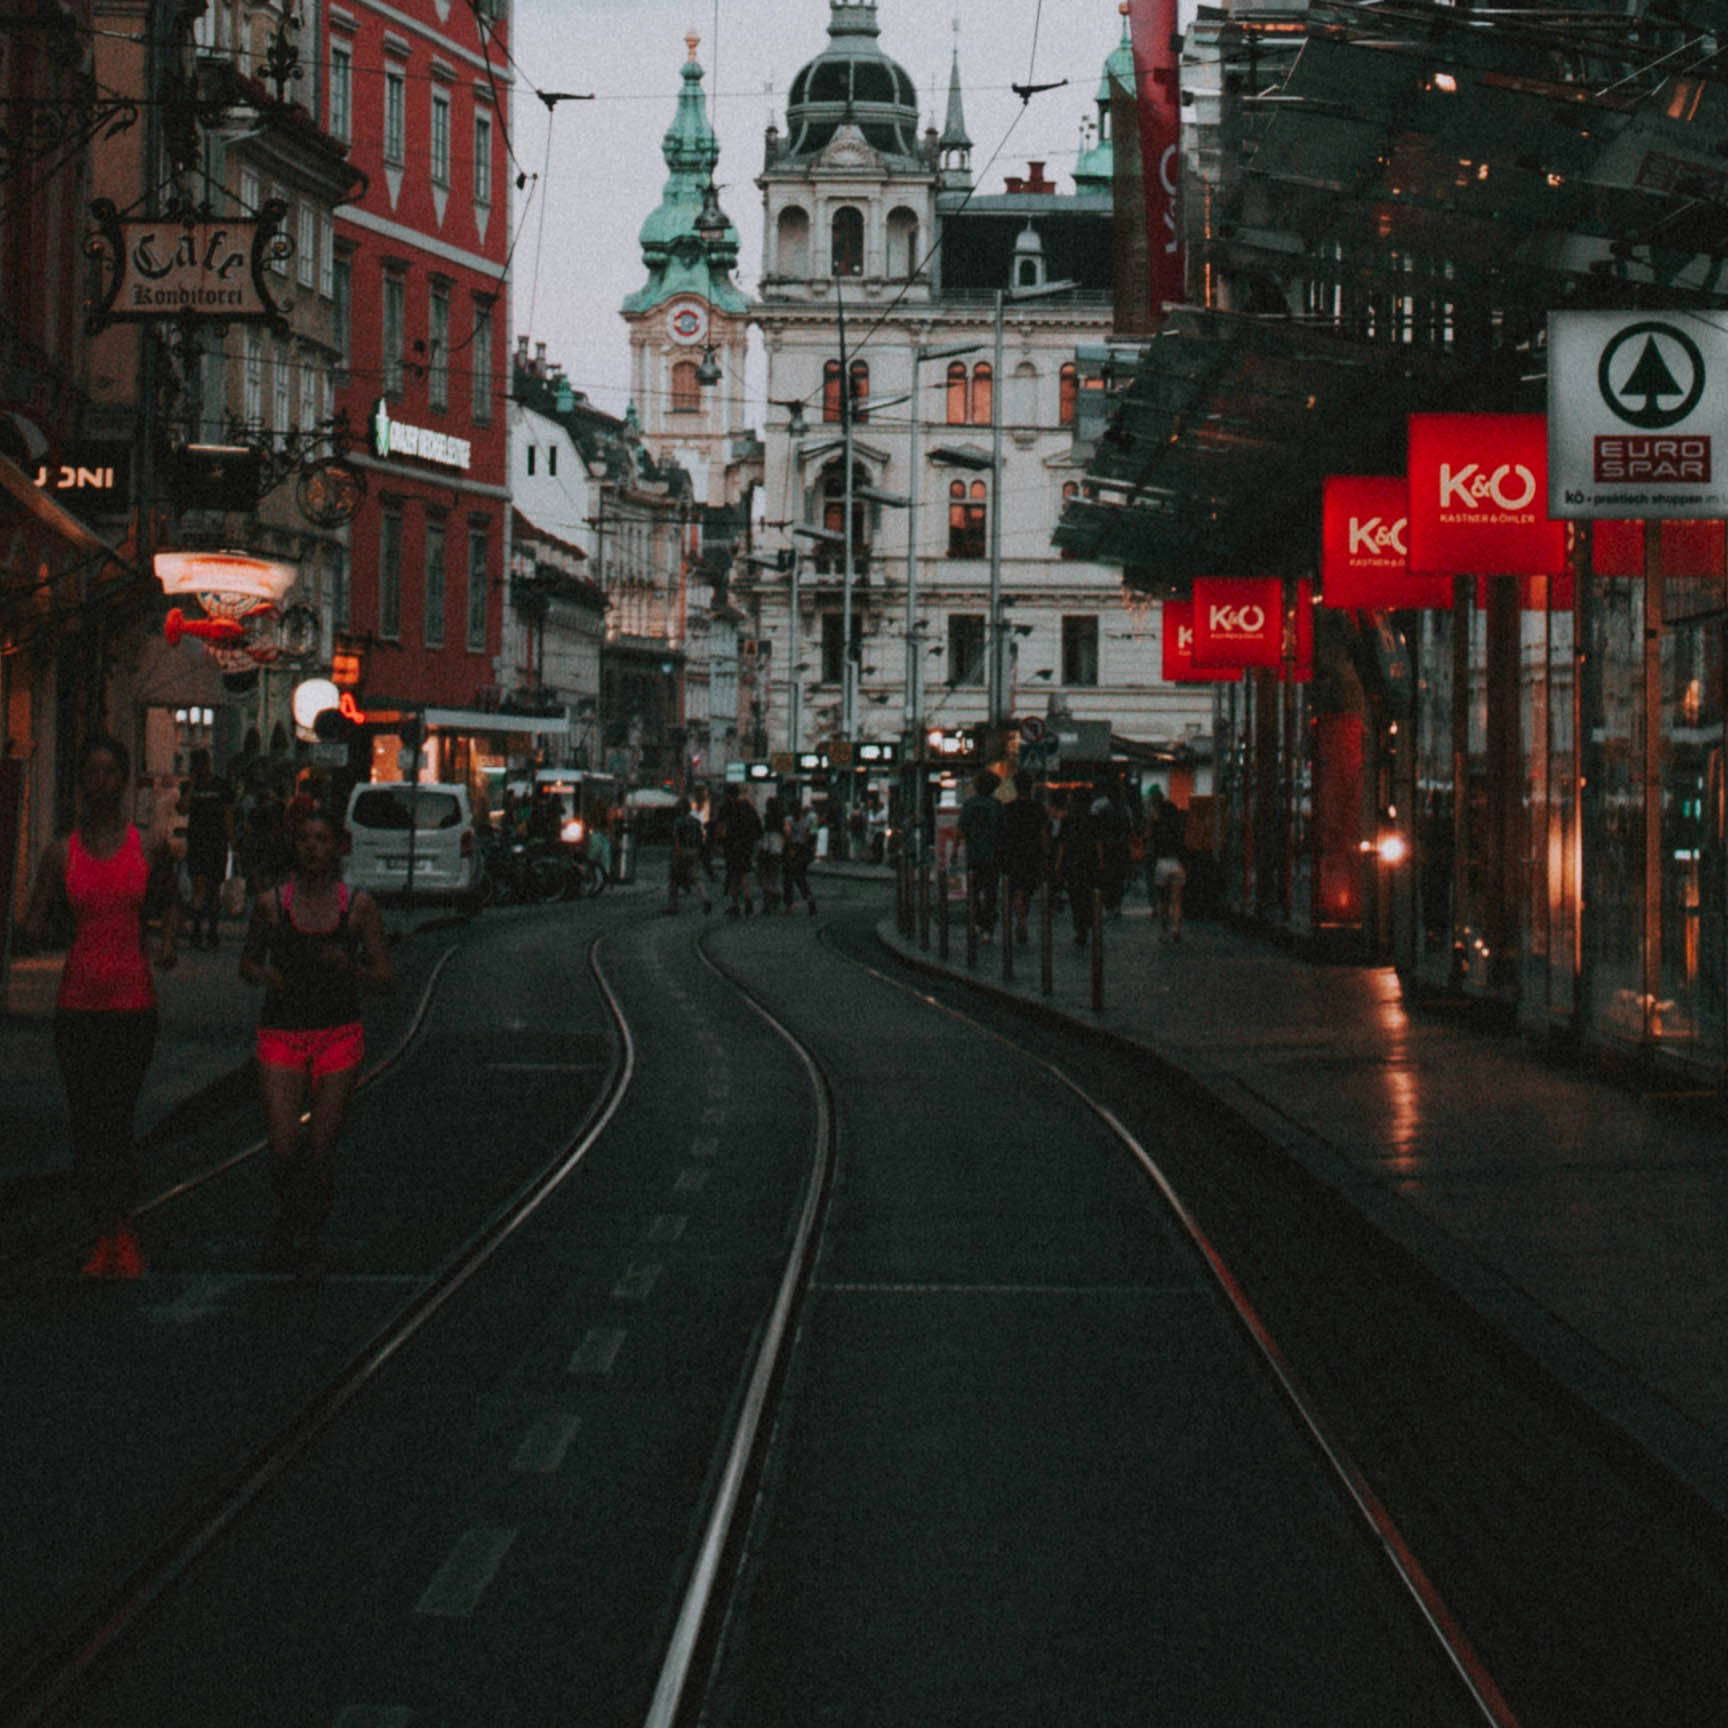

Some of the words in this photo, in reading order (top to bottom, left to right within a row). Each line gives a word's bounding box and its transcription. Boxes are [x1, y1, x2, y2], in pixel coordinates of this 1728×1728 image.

[133, 283, 243, 305] Konditorei
[1600, 440, 1705, 458] EURO
[1601, 460, 1704, 477] SPAR
